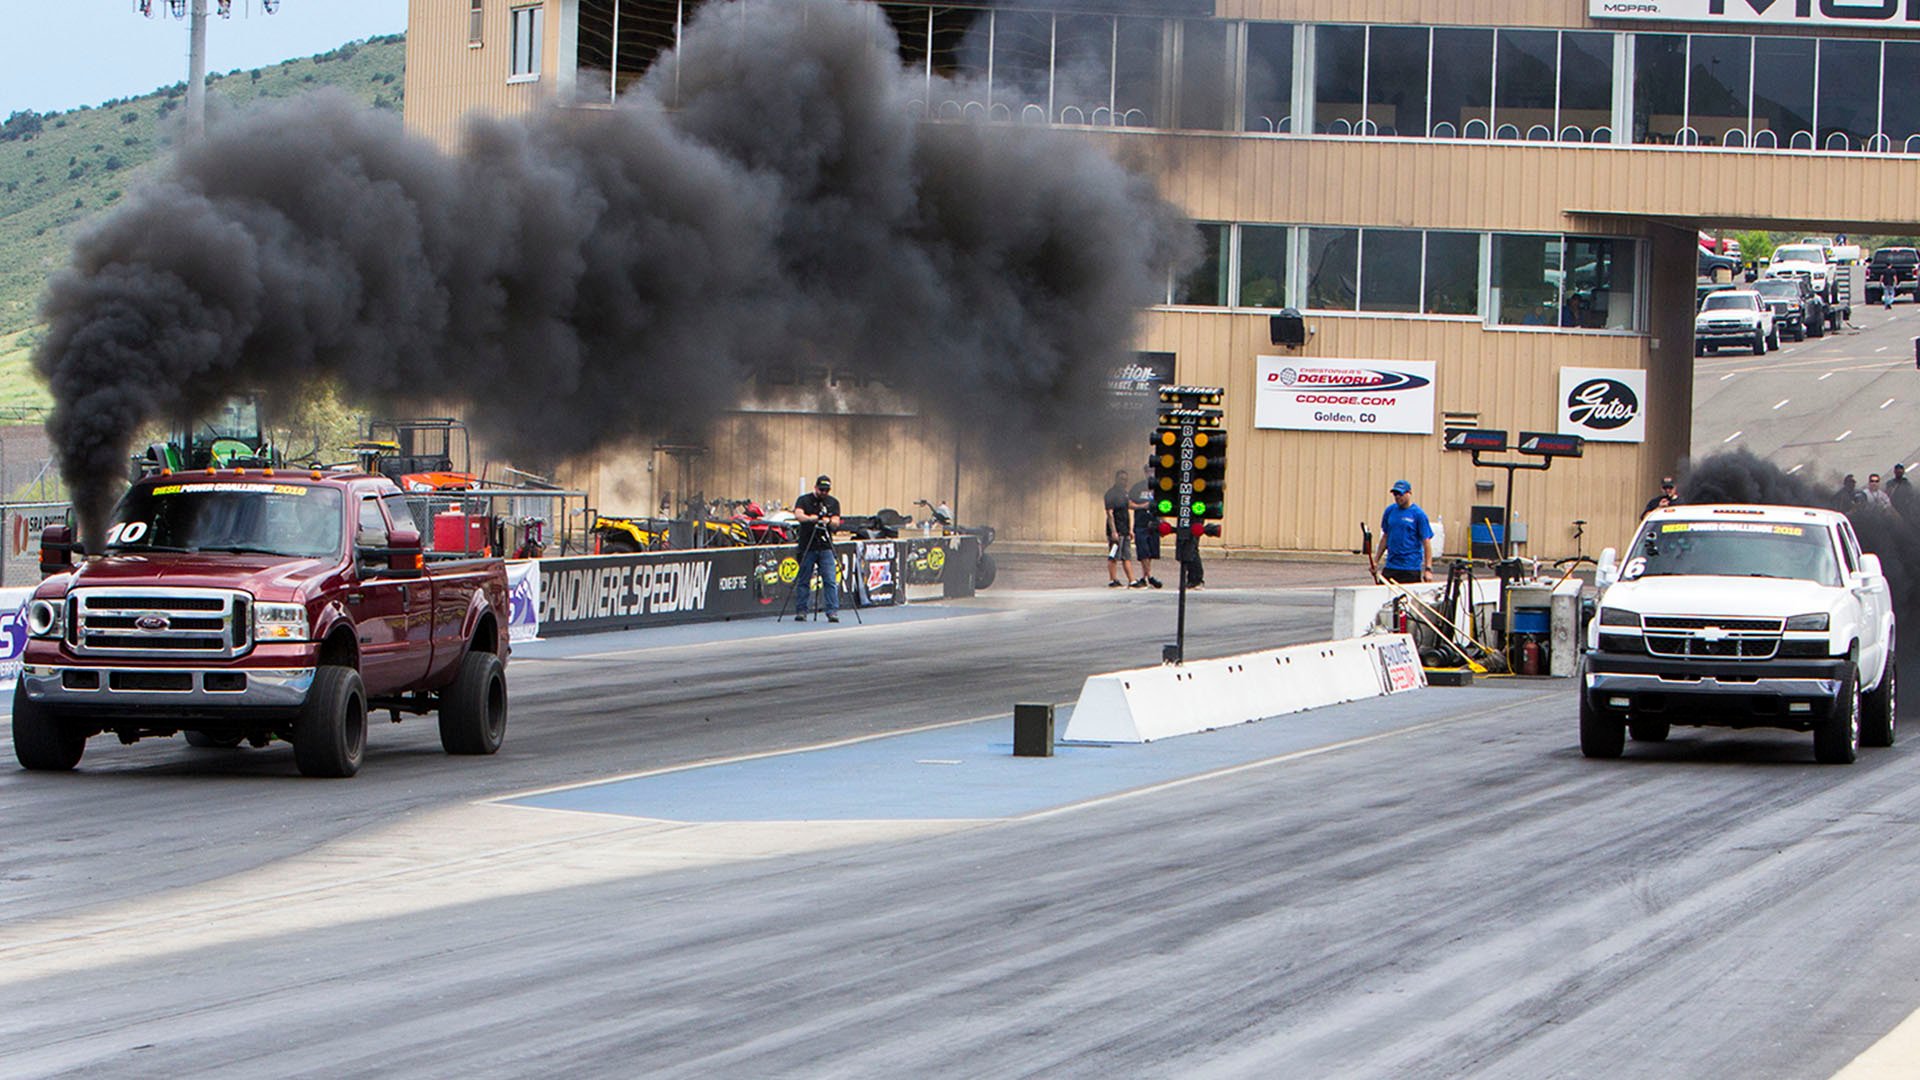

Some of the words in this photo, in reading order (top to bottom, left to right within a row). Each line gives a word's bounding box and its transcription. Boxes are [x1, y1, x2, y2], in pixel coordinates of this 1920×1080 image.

[1604, 4, 1658, 13] MOPAR
[1159, 385, 1219, 394] PRE-STAGE
[1567, 382, 1637, 424] Gates
[1314, 411, 1356, 423] Golden,
[1359, 413, 1376, 423] CO
[1180, 425, 1194, 527] BANDIMERE
[180, 483, 214, 493] POWER
[107, 522, 147, 545] 10
[1624, 557, 1647, 578] 6
[539, 566, 631, 622] BANDIMERE
[630, 561, 712, 615] SPEEDWAY
